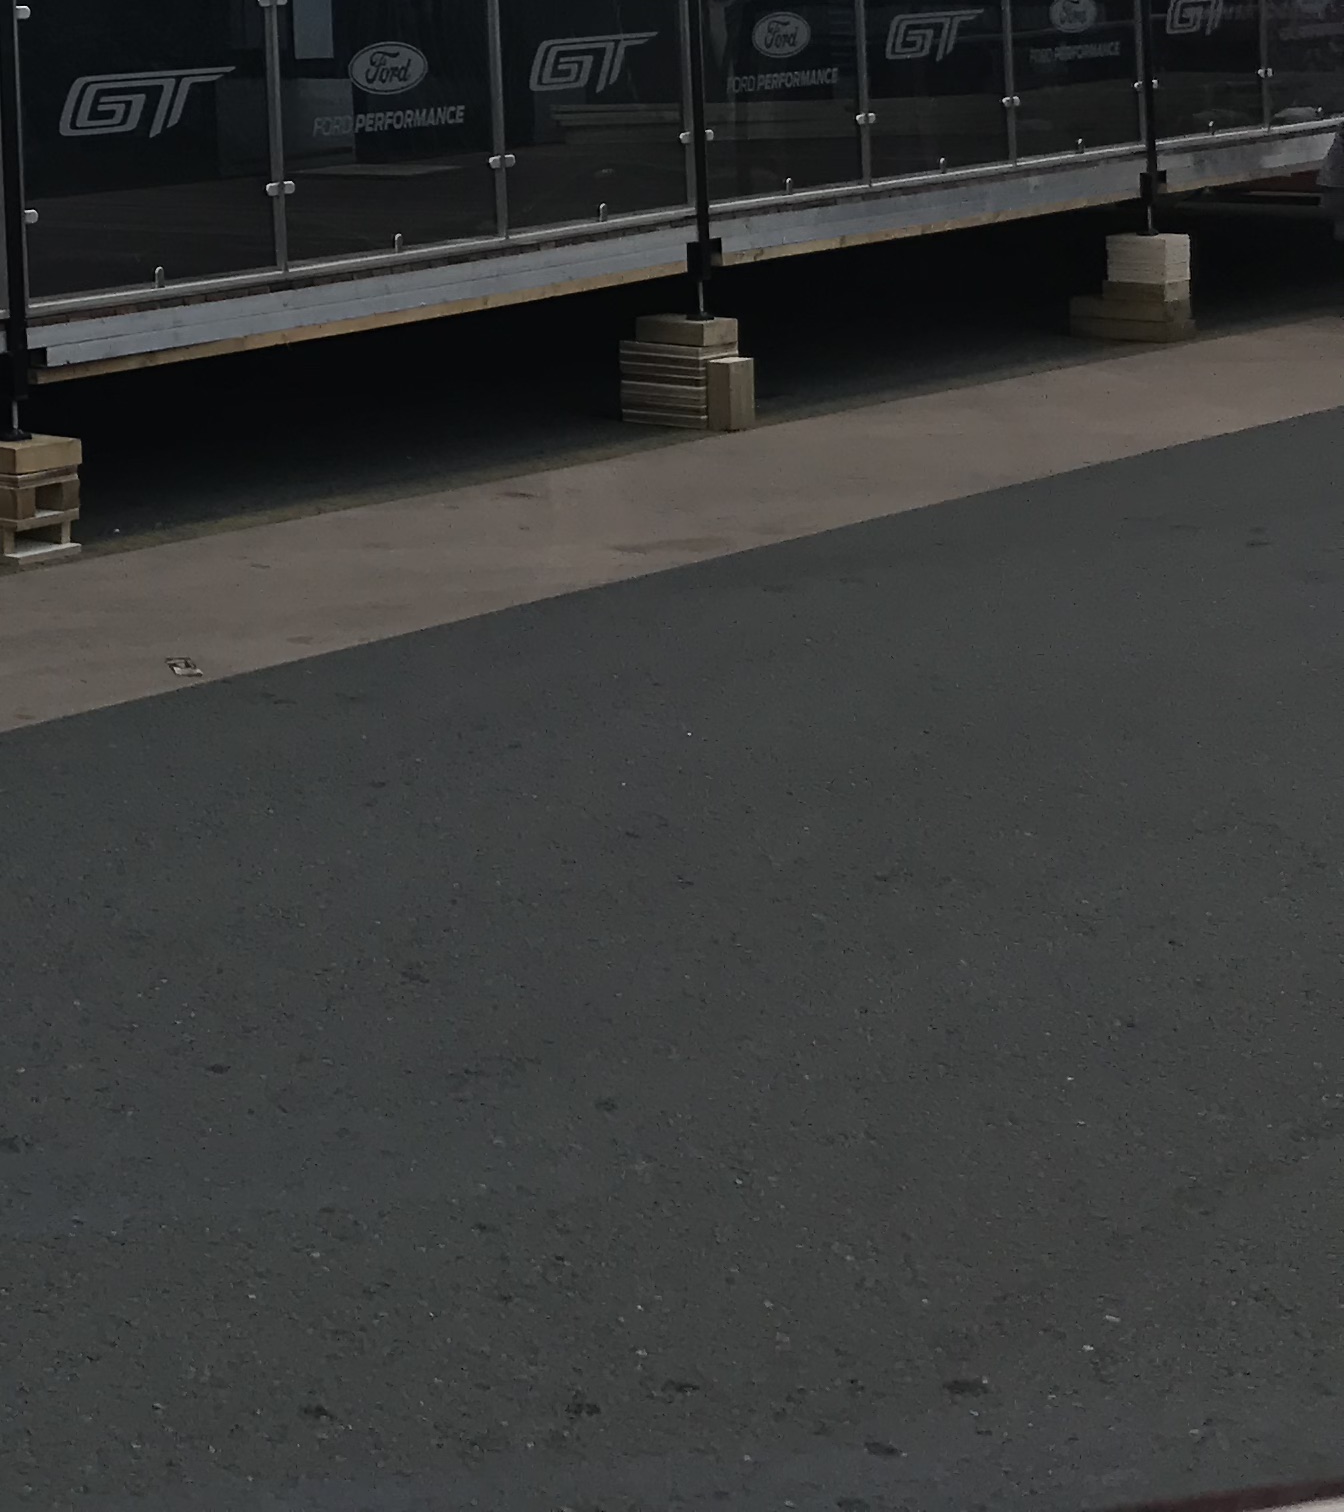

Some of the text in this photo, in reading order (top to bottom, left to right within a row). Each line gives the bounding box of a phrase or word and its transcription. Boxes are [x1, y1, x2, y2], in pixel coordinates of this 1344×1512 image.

[764, 20, 800, 49] Ford
[885, 7, 985, 62] GT
[365, 51, 412, 85] Ford
[529, 31, 660, 94] GT
[757, 67, 839, 90] PERFORMANCE
[58, 65, 237, 138] GT
[313, 104, 465, 137] FORD PERFORMANCE
